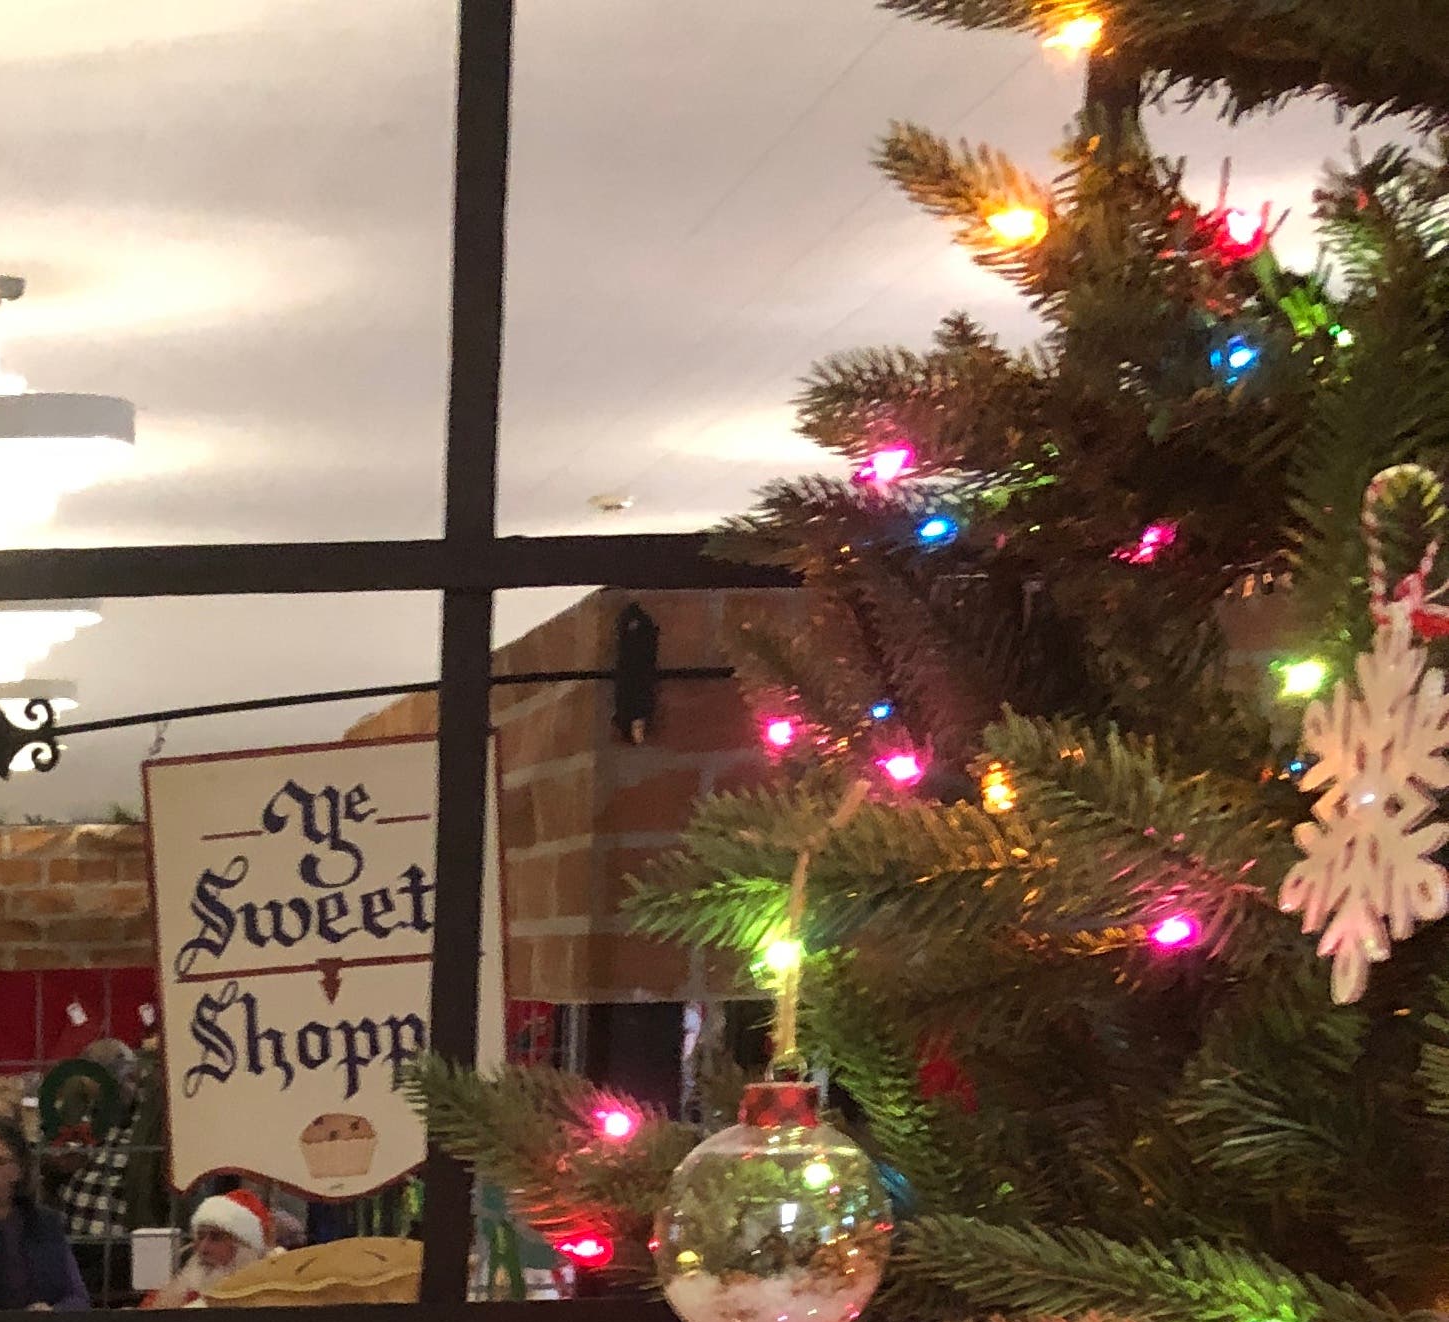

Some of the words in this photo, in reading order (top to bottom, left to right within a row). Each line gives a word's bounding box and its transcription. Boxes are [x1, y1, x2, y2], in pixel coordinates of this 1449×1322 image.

[261, 779, 377, 888] Ye
[174, 855, 436, 977] Sweet
[183, 980, 429, 1099] Shopp
